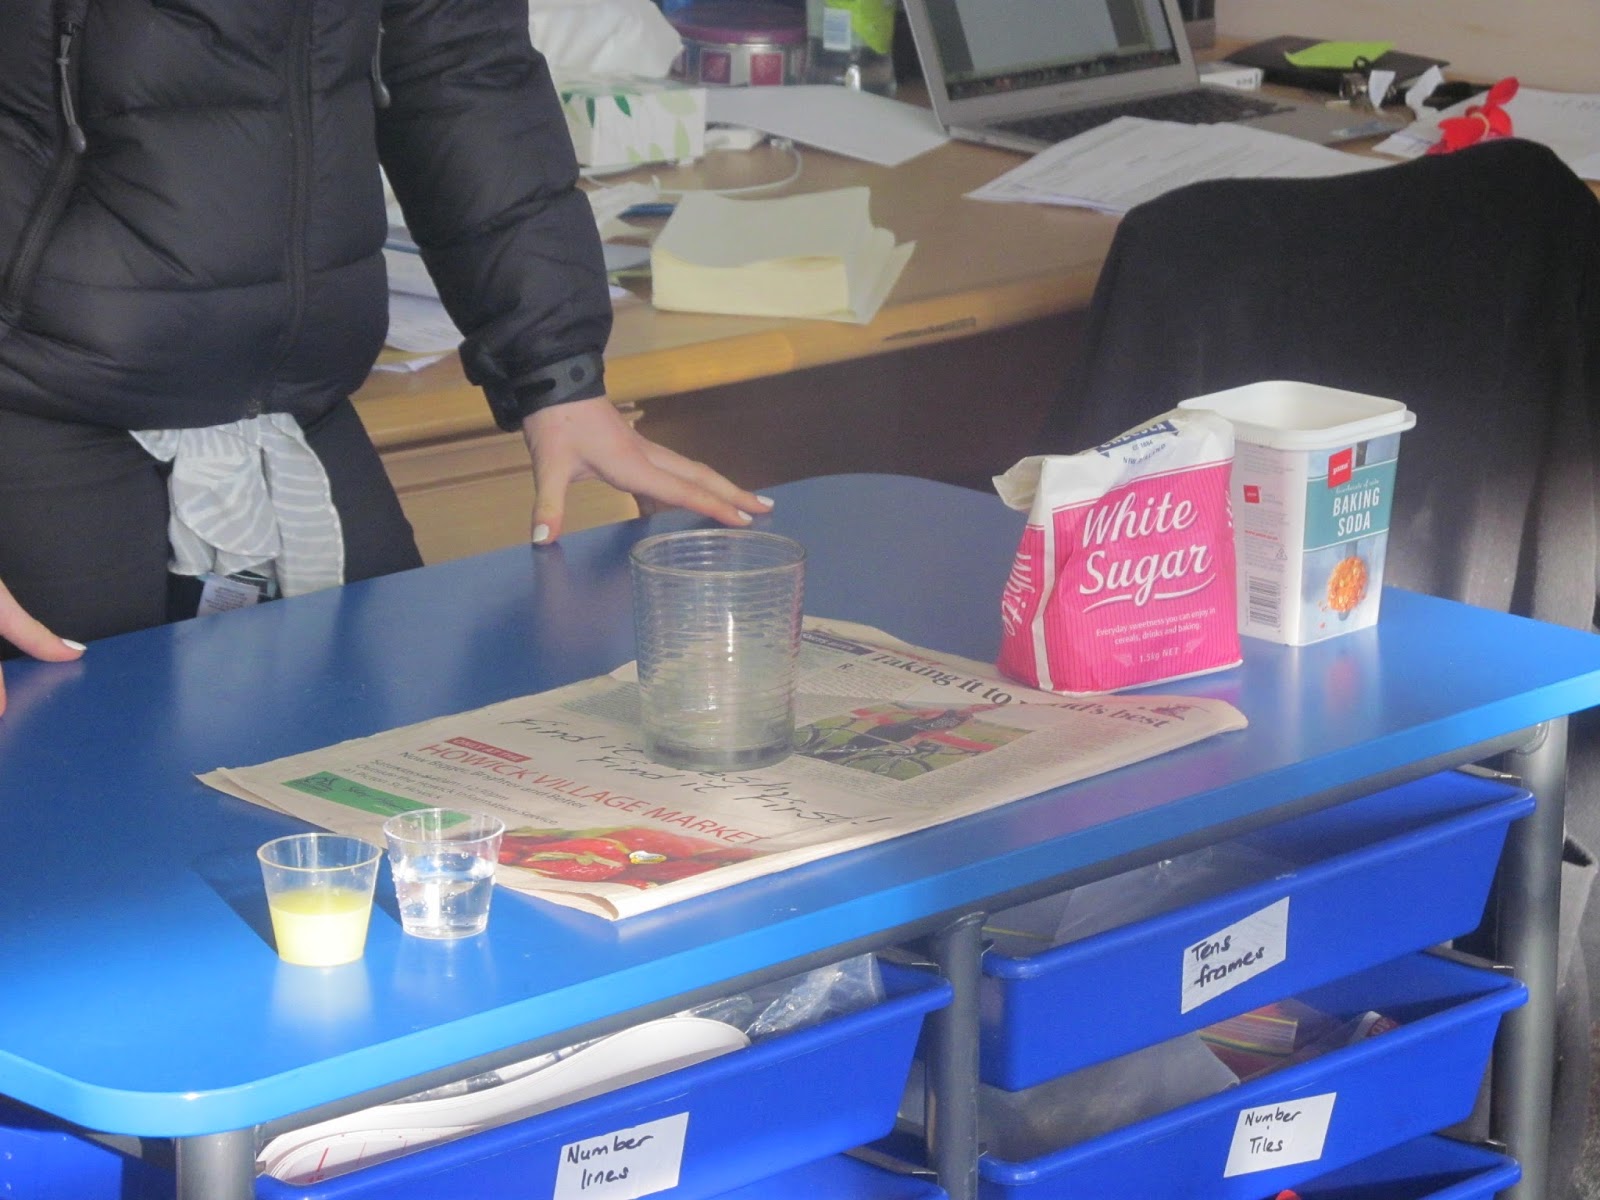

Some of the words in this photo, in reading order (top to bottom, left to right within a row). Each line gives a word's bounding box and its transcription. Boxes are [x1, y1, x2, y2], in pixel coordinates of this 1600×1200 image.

[1332, 486, 1380, 517] BAKING
[1082, 491, 1198, 548] White
[1337, 510, 1371, 537] SODA
[1079, 543, 1213, 607] Sugar
[1096, 625, 1128, 637] Everyday
[1129, 618, 1165, 631] sweetness
[1165, 615, 1178, 625] you
[1179, 612, 1191, 621] can
[1191, 609, 1209, 620] enjoy
[1209, 607, 1216, 615] in
[1142, 630, 1163, 640] drinks
[1164, 627, 1177, 636] and
[1162, 646, 1180, 657] NET
[871, 653, 962, 686] Taking
[956, 678, 985, 694] it
[981, 685, 1013, 705] to
[1108, 709, 1170, 728] best
[499, 719, 606, 743] Find
[576, 756, 686, 780] Find
[680, 779, 735, 793] it
[417, 743, 540, 779] HOWICK
[532, 774, 651, 813] VILLAGE
[641, 806, 772, 844] MARKET
[519, 786, 550, 797] and
[546, 793, 588, 808] Better
[1191, 935, 1232, 961] Tens
[1193, 946, 1265, 988] frames
[1244, 1106, 1302, 1126] Number
[567, 1135, 654, 1164] Number
[1249, 1135, 1284, 1154] Tiles
[580, 1167, 630, 1190] lines
